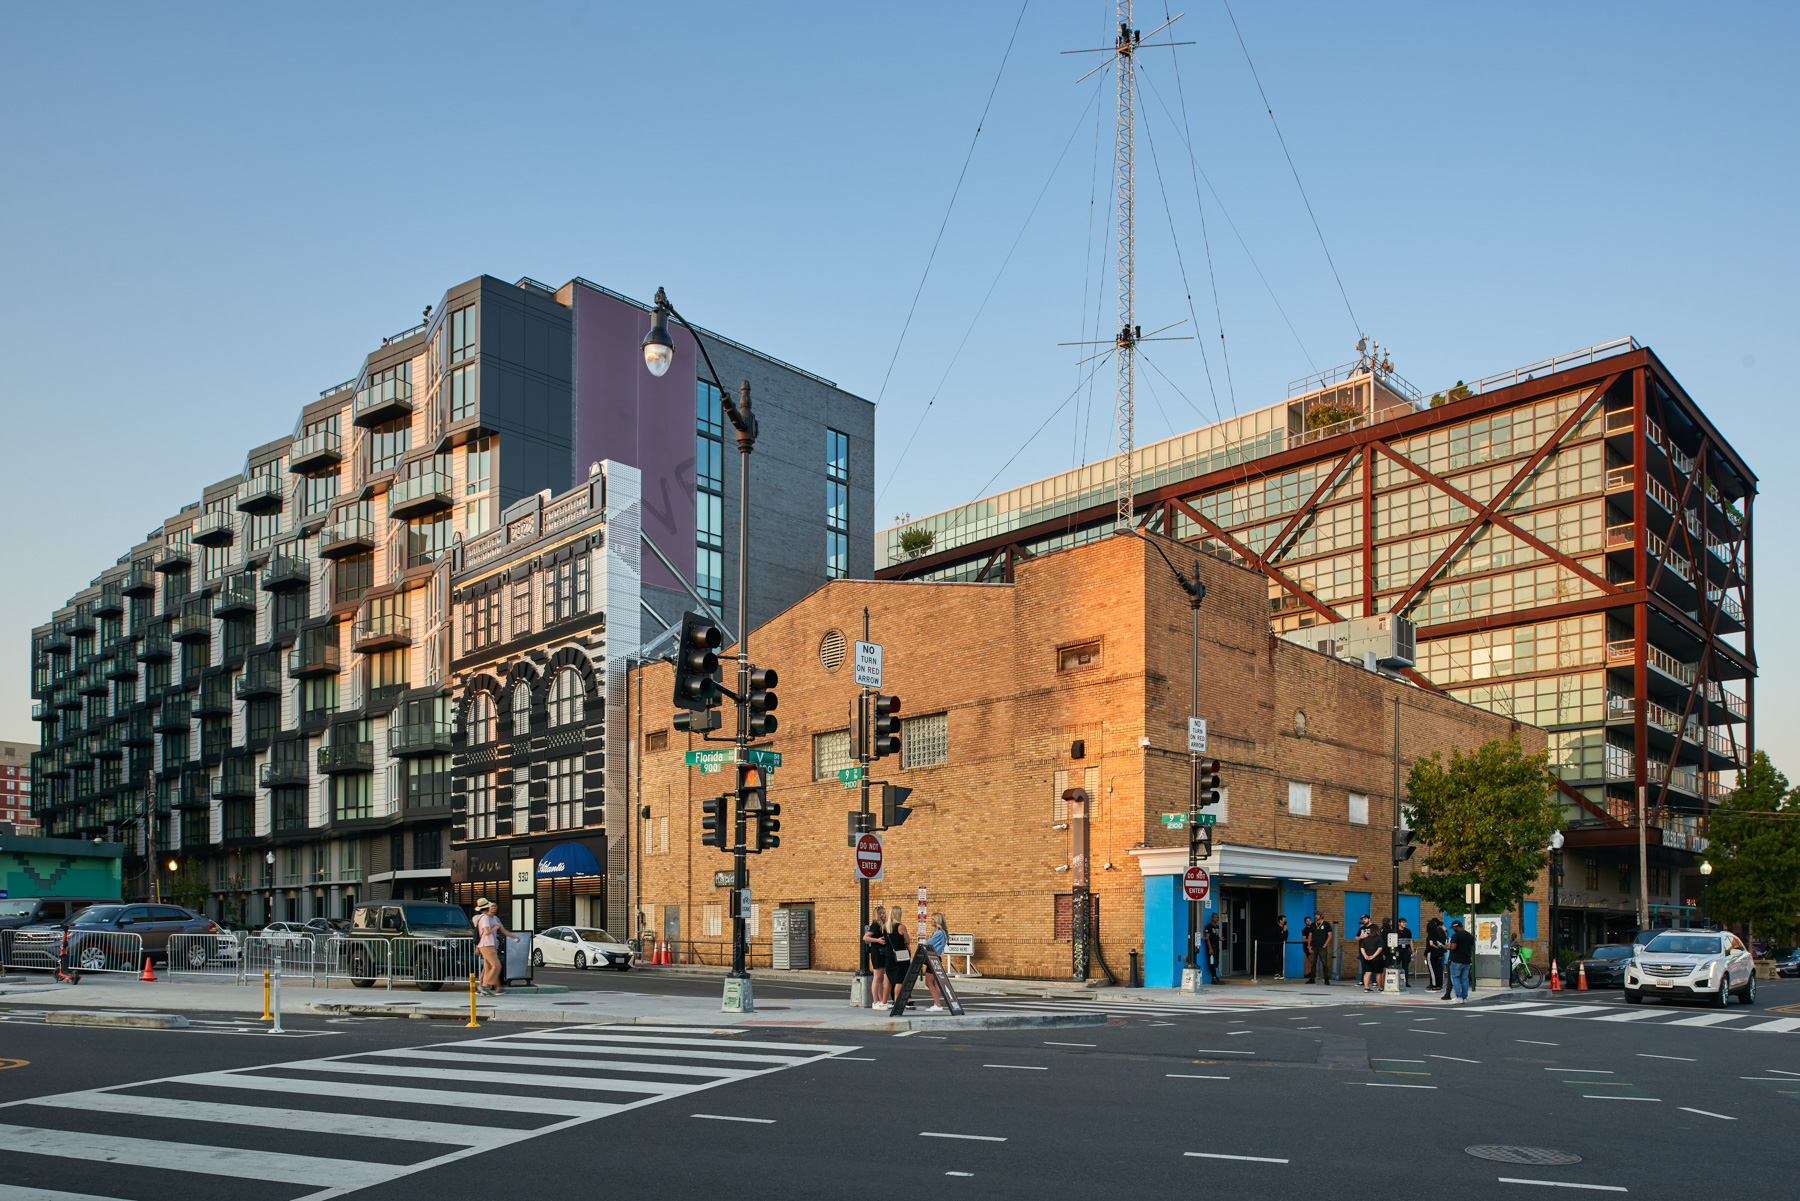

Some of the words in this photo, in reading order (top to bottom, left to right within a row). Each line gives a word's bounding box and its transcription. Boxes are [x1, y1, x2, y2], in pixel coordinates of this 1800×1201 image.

[863, 645, 875, 654] NO
[861, 656, 876, 664] TURN
[868, 666, 880, 675] RED
[858, 675, 880, 684] ARROW
[696, 751, 722, 763] Florida
[756, 752, 764, 762] V
[704, 764, 718, 772] 900
[846, 770, 849, 780] 9
[844, 780, 856, 788] 2100
